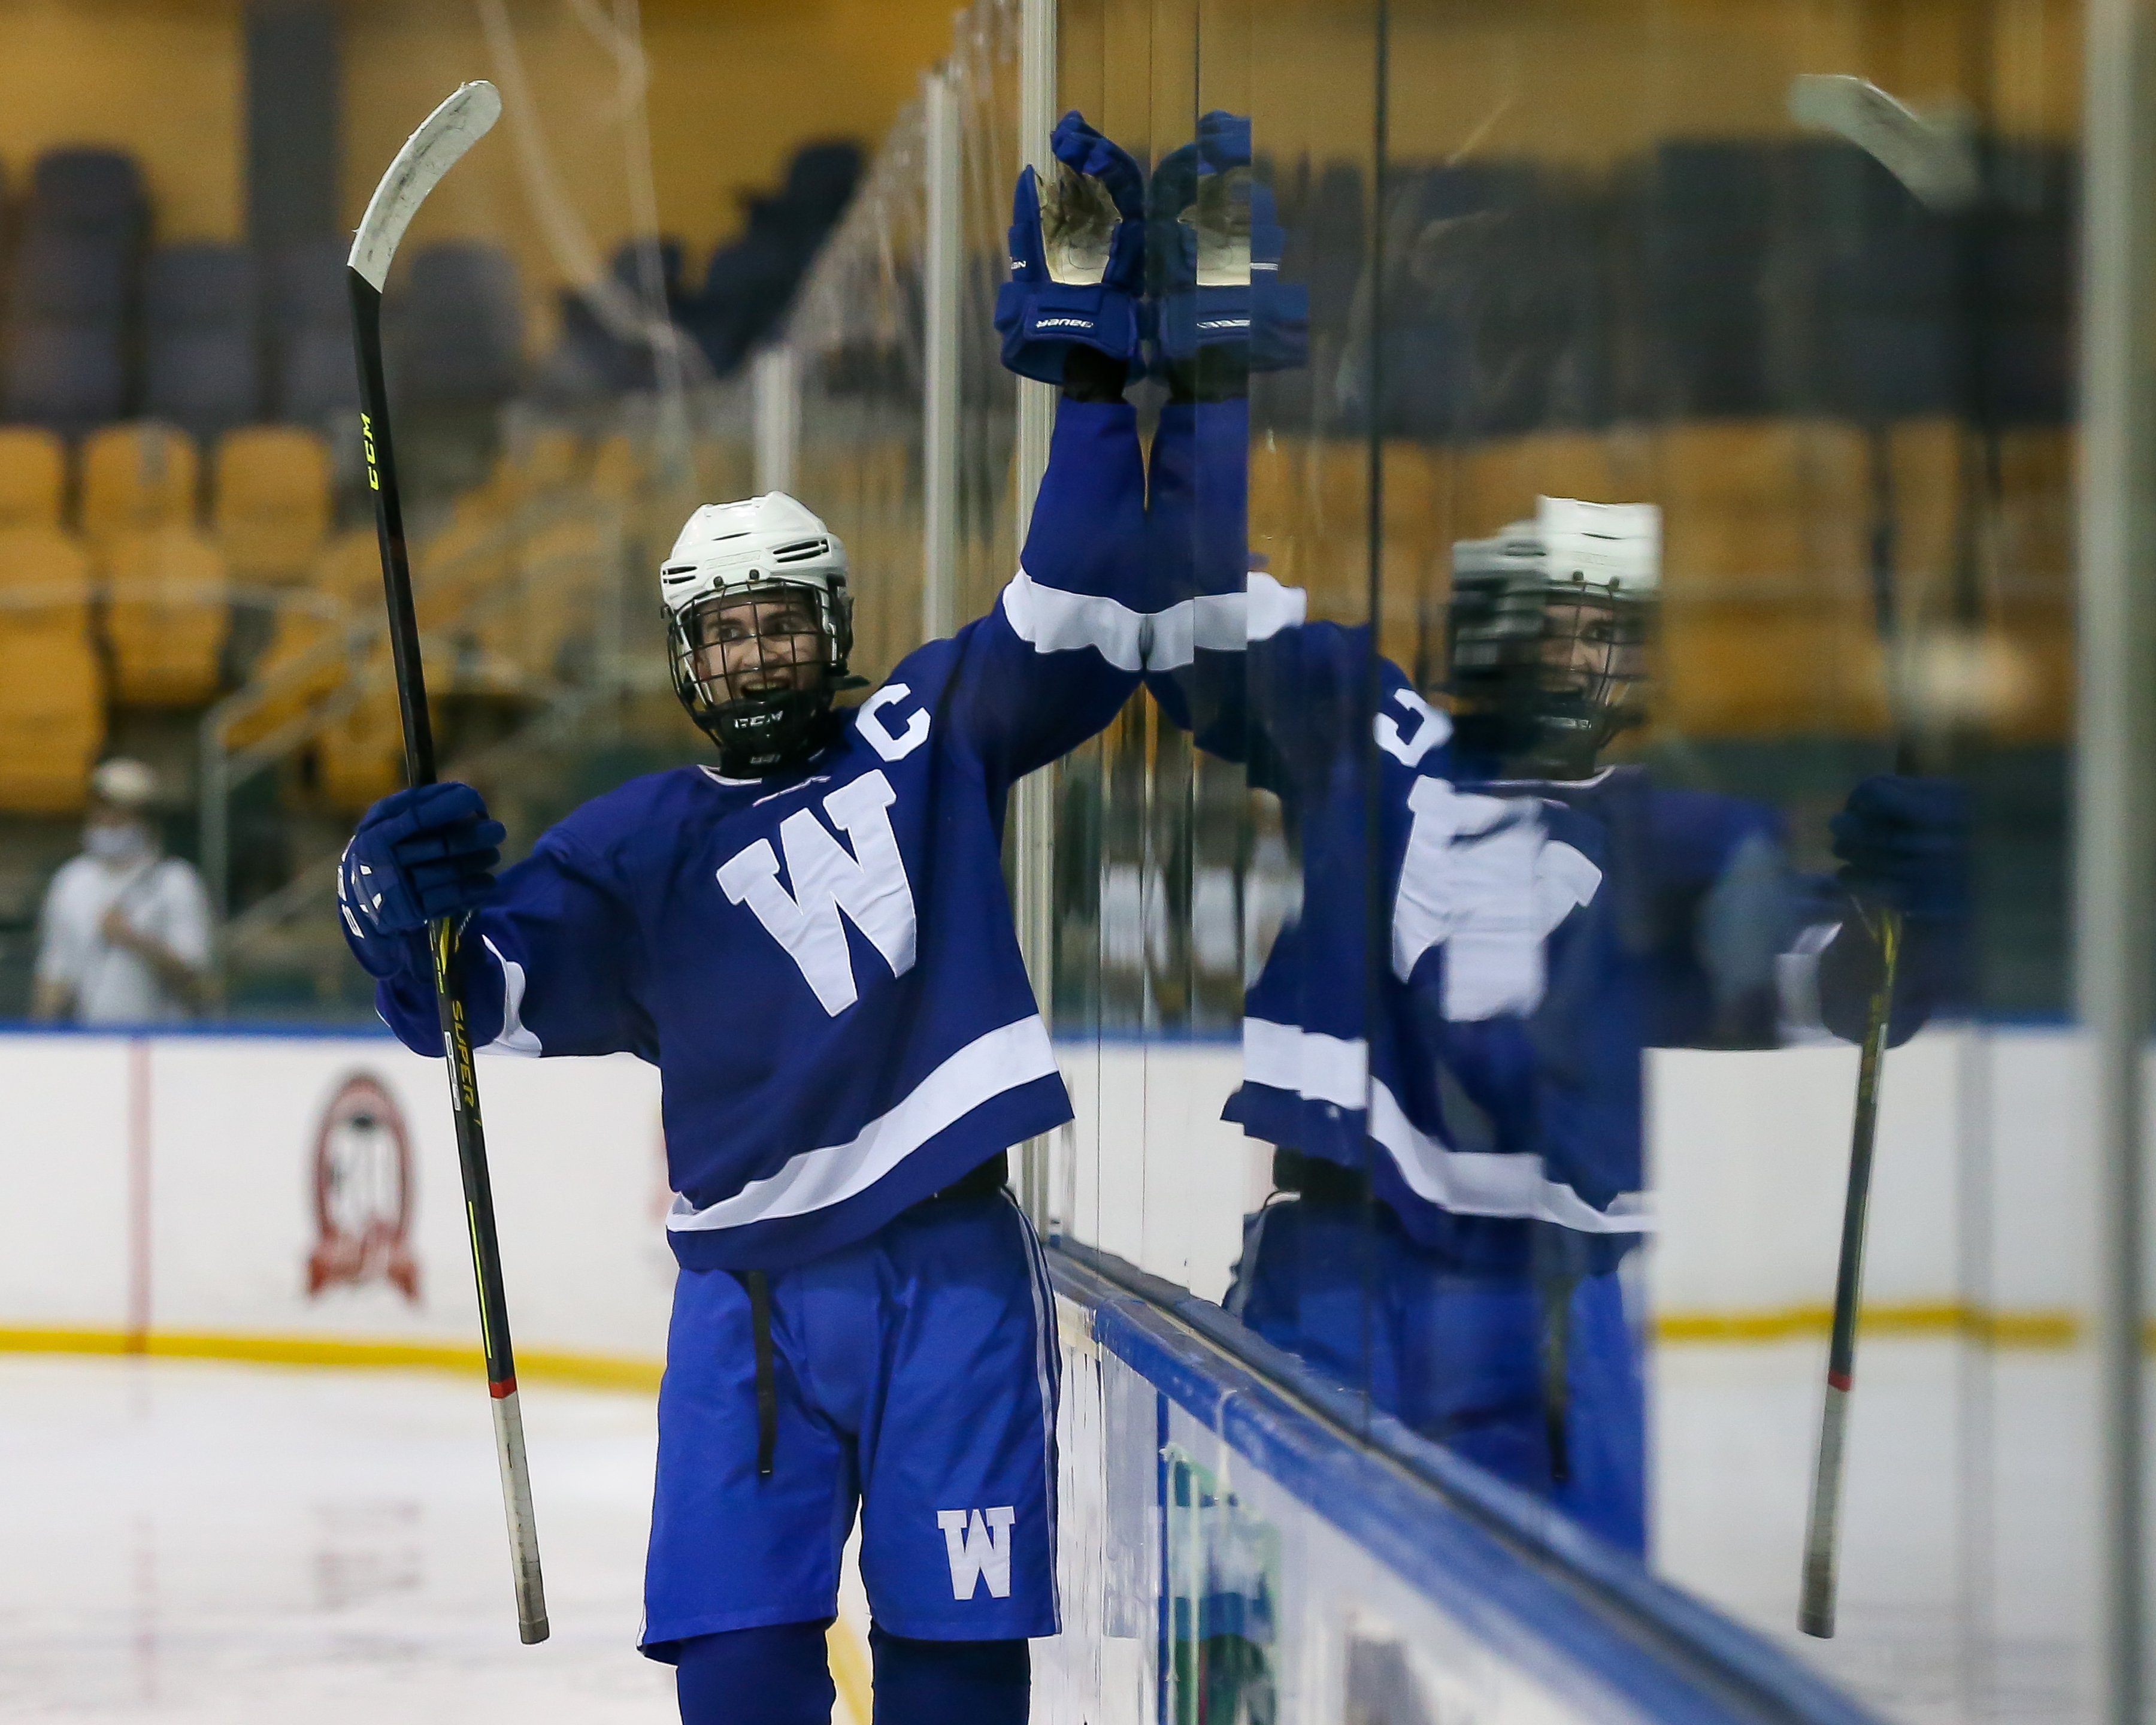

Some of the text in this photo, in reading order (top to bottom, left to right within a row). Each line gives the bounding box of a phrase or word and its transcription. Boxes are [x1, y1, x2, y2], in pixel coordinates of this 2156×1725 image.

[361, 412, 380, 491] CCM
[855, 682, 932, 762] C
[716, 768, 917, 1018] W
[452, 1000, 475, 1107] SUPER
[937, 1506, 1015, 1600] W
